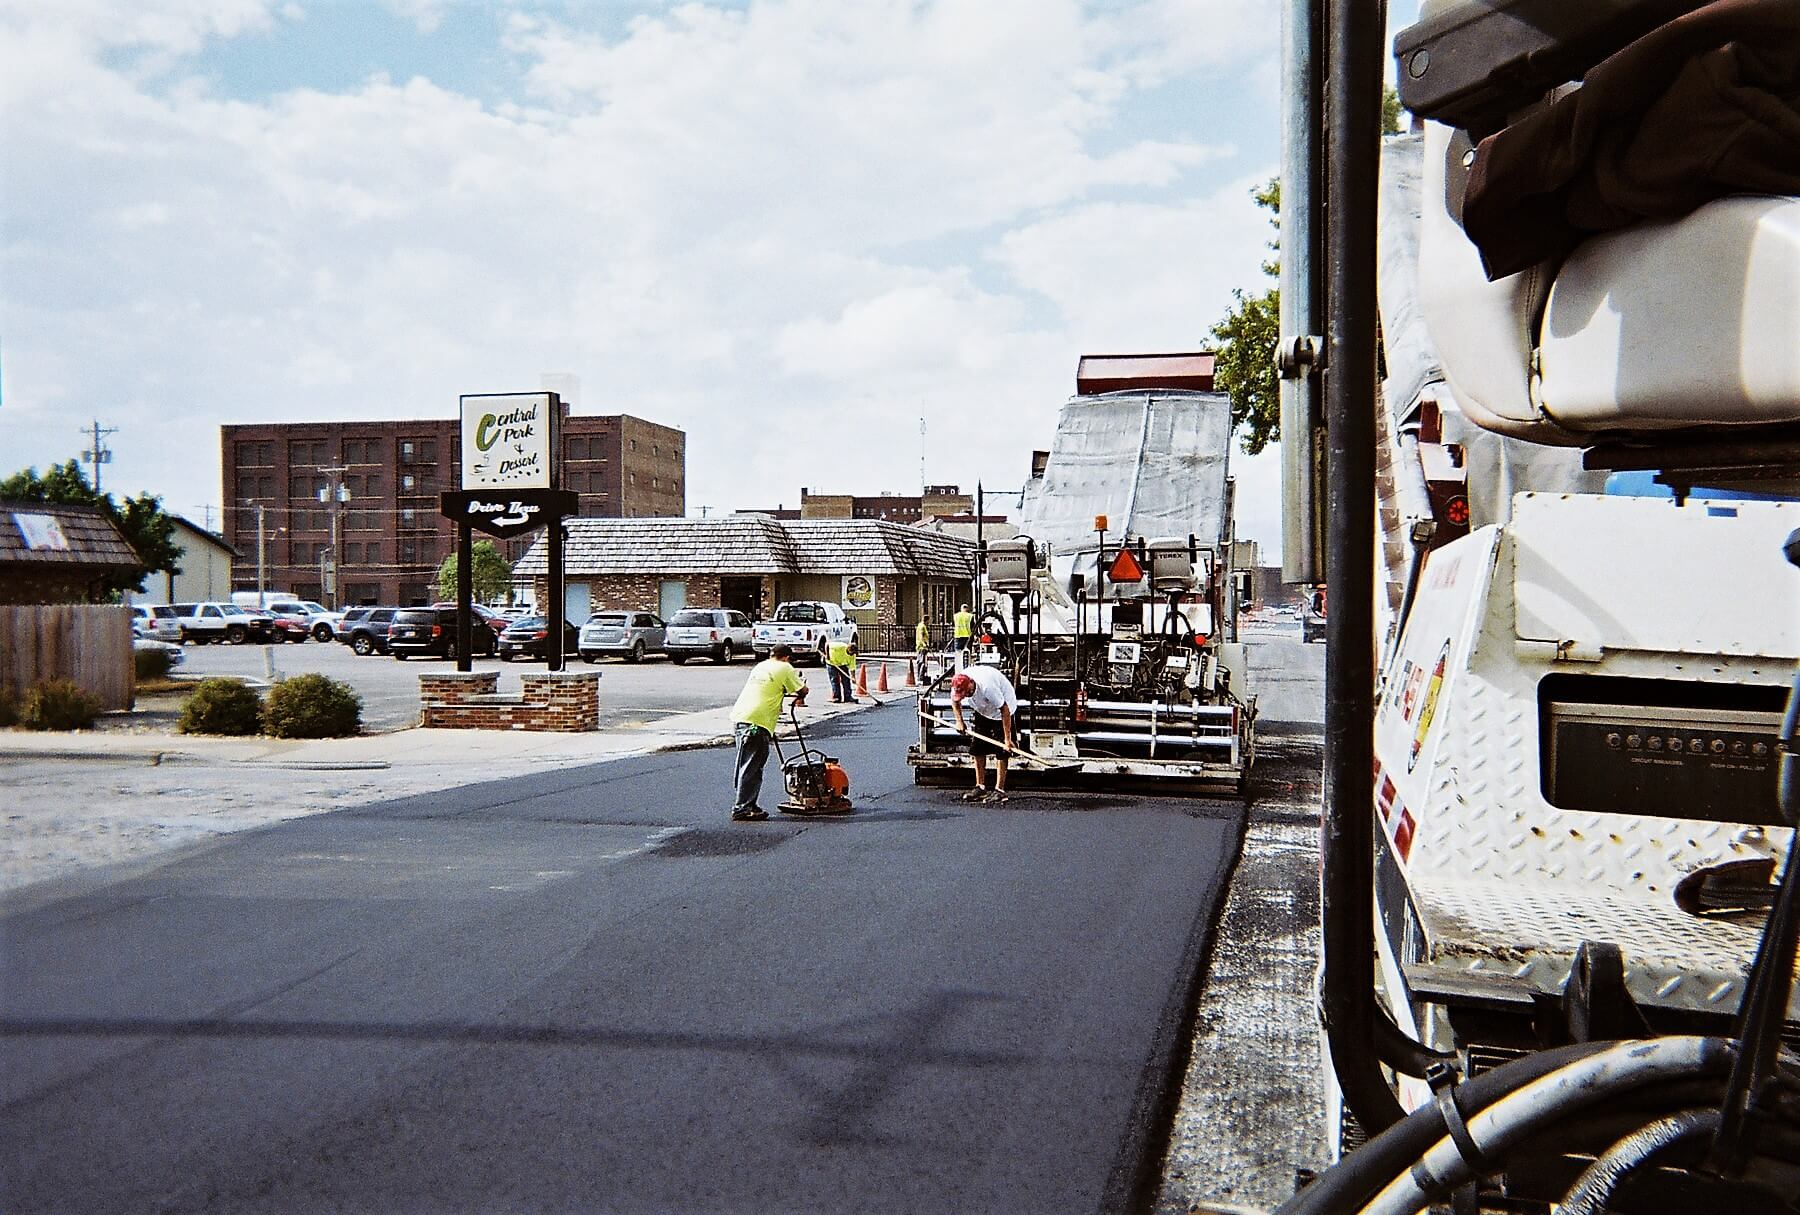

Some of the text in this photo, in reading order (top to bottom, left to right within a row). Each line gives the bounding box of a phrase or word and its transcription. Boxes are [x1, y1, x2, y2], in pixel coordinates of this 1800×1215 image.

[476, 403, 538, 452] Central
[499, 453, 538, 474] Dessert
[467, 500, 506, 514] Drive
